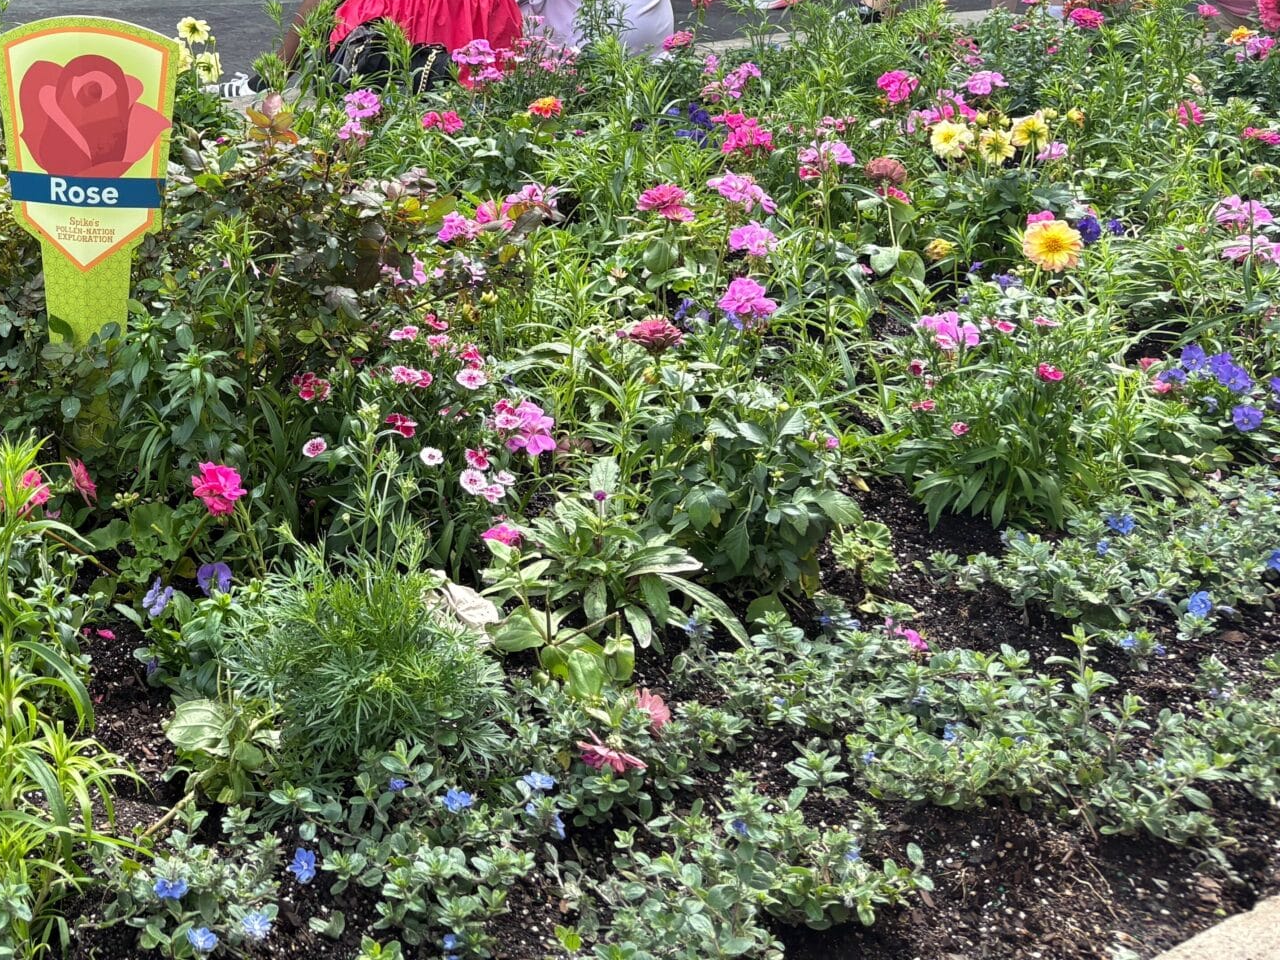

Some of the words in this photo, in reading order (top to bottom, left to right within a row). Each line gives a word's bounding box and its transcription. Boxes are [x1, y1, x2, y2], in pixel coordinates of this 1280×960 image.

[50, 176, 119, 205] Rose
[69, 216, 100, 228] Spike's
[55, 225, 116, 236] POLLEN-NATION
[57, 232, 114, 243] EXPLORATION
